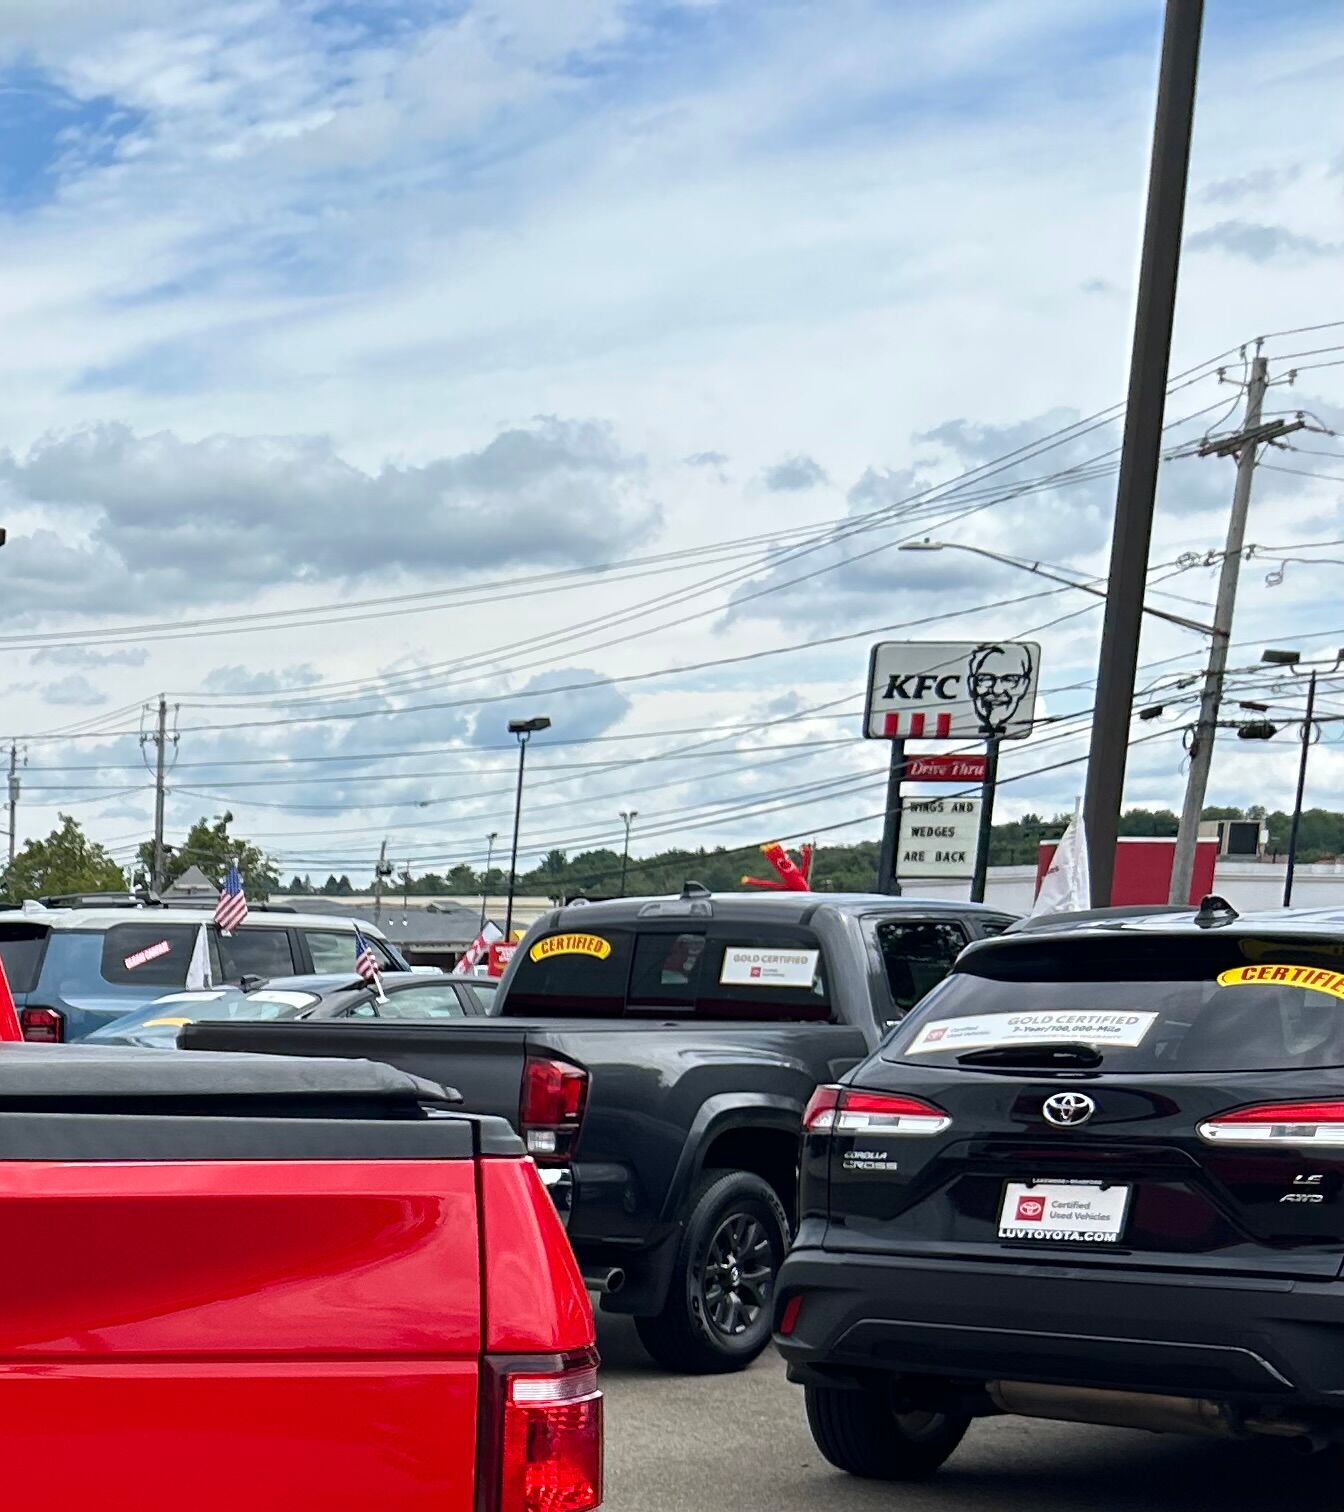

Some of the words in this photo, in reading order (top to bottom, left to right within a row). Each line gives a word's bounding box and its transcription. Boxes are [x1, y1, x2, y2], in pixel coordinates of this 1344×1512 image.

[882, 674, 961, 699] KFC
[911, 759, 947, 775] Drive
[951, 761, 984, 775] Thru
[910, 801, 944, 812] WINGS
[952, 801, 974, 812] AND
[911, 826, 955, 837] WEDGES
[903, 850, 925, 862] ARE
[935, 850, 966, 862] BACK
[541, 936, 604, 955] CERTIFIED
[1241, 966, 1344, 995] CERTIFIE
[1008, 1016, 1054, 1025] GOLD
[1056, 1015, 1140, 1026] CERTIFIED
[844, 1151, 887, 1159] COROLLA
[843, 1160, 897, 1170] CROSS
[1293, 1174, 1323, 1184] LE
[1279, 1193, 1324, 1202] AWD
[1051, 1200, 1091, 1209] Certified
[1049, 1211, 1072, 1220] Used
[1074, 1211, 1111, 1221] Vehicles
[998, 1228, 1117, 1242] LUVTOYOTA.COM
